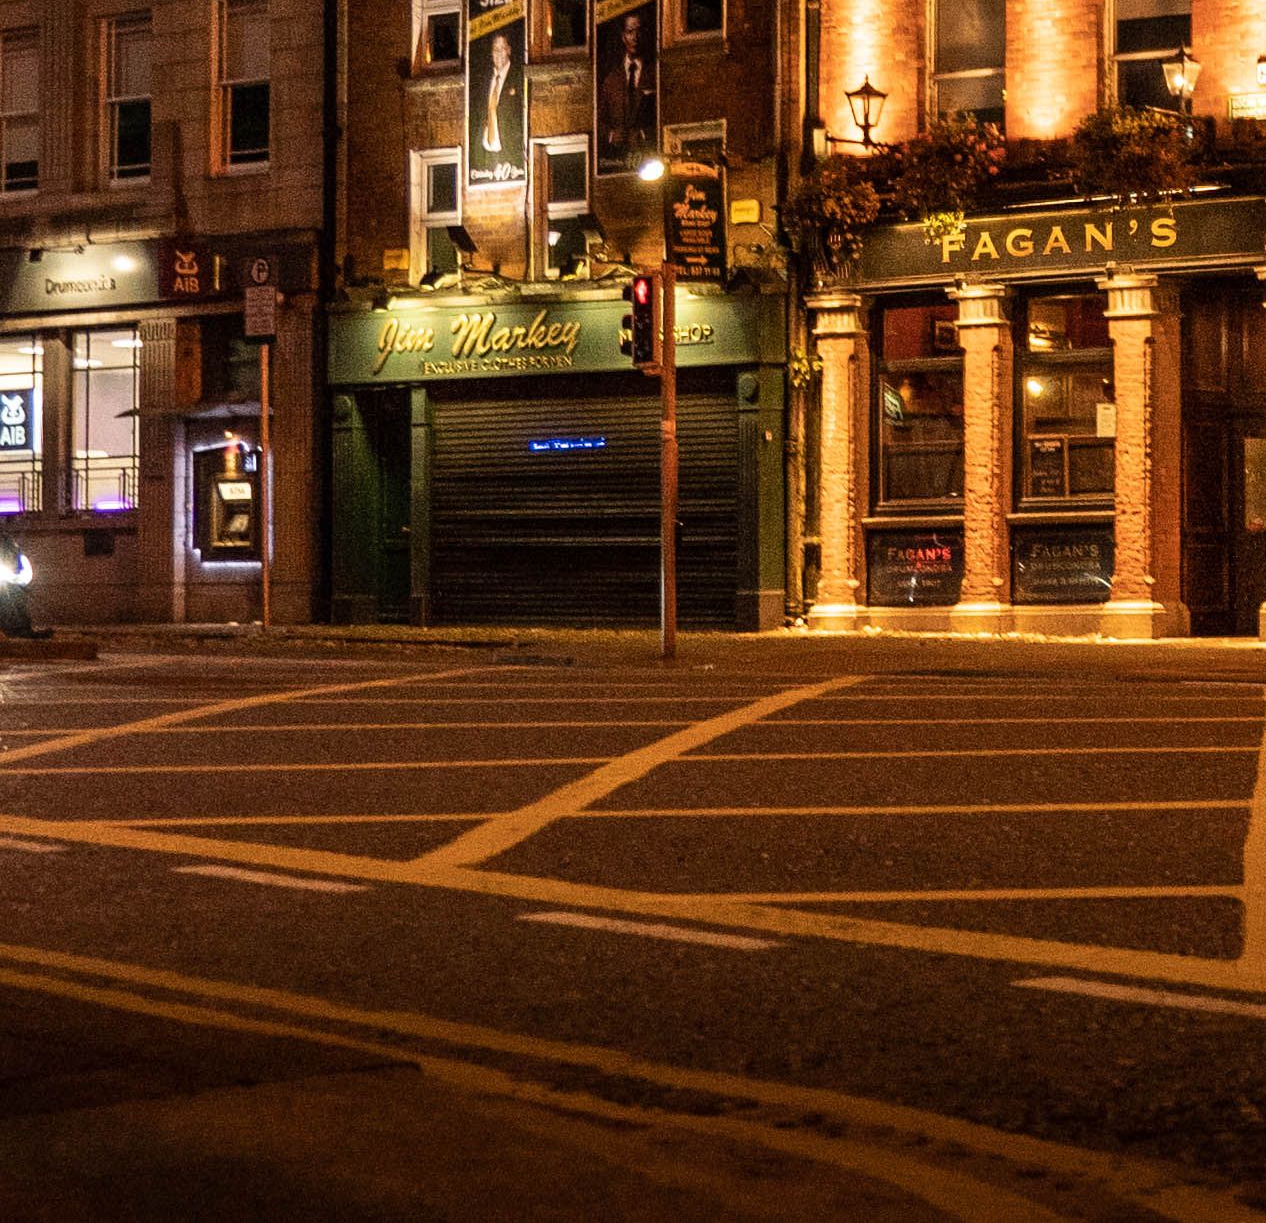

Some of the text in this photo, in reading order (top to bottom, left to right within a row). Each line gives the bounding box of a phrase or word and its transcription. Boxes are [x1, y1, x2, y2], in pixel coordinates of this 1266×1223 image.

[942, 218, 1177, 263] FAGAN'S
[174, 277, 199, 292] AIB
[374, 309, 581, 375] Jim Markey
[0, 426, 26, 446] AIB
[887, 547, 951, 561] FAGAN'S
